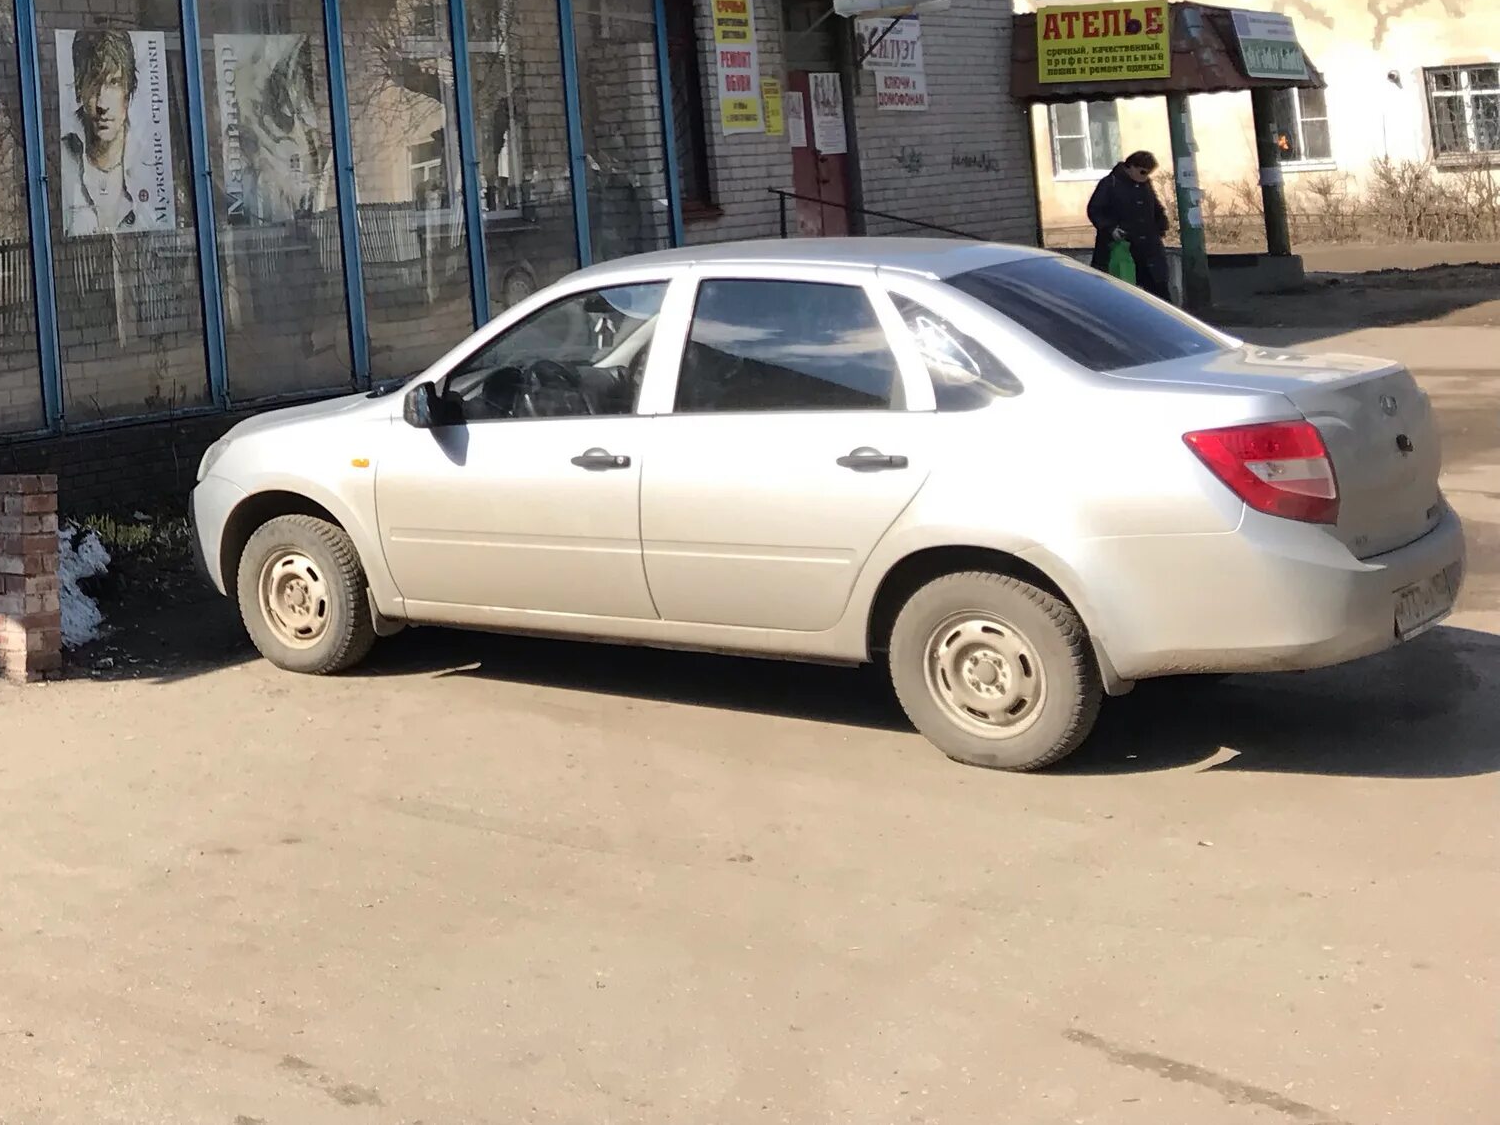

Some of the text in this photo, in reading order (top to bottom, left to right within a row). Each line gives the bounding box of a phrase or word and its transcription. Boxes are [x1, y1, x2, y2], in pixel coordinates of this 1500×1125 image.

[1043, 6, 1164, 41] АТЕЛЬЕ
[1047, 52, 1164, 67] профессиональный
[1089, 65, 1124, 75] ремонт
[153, 132, 170, 224] Мужские
